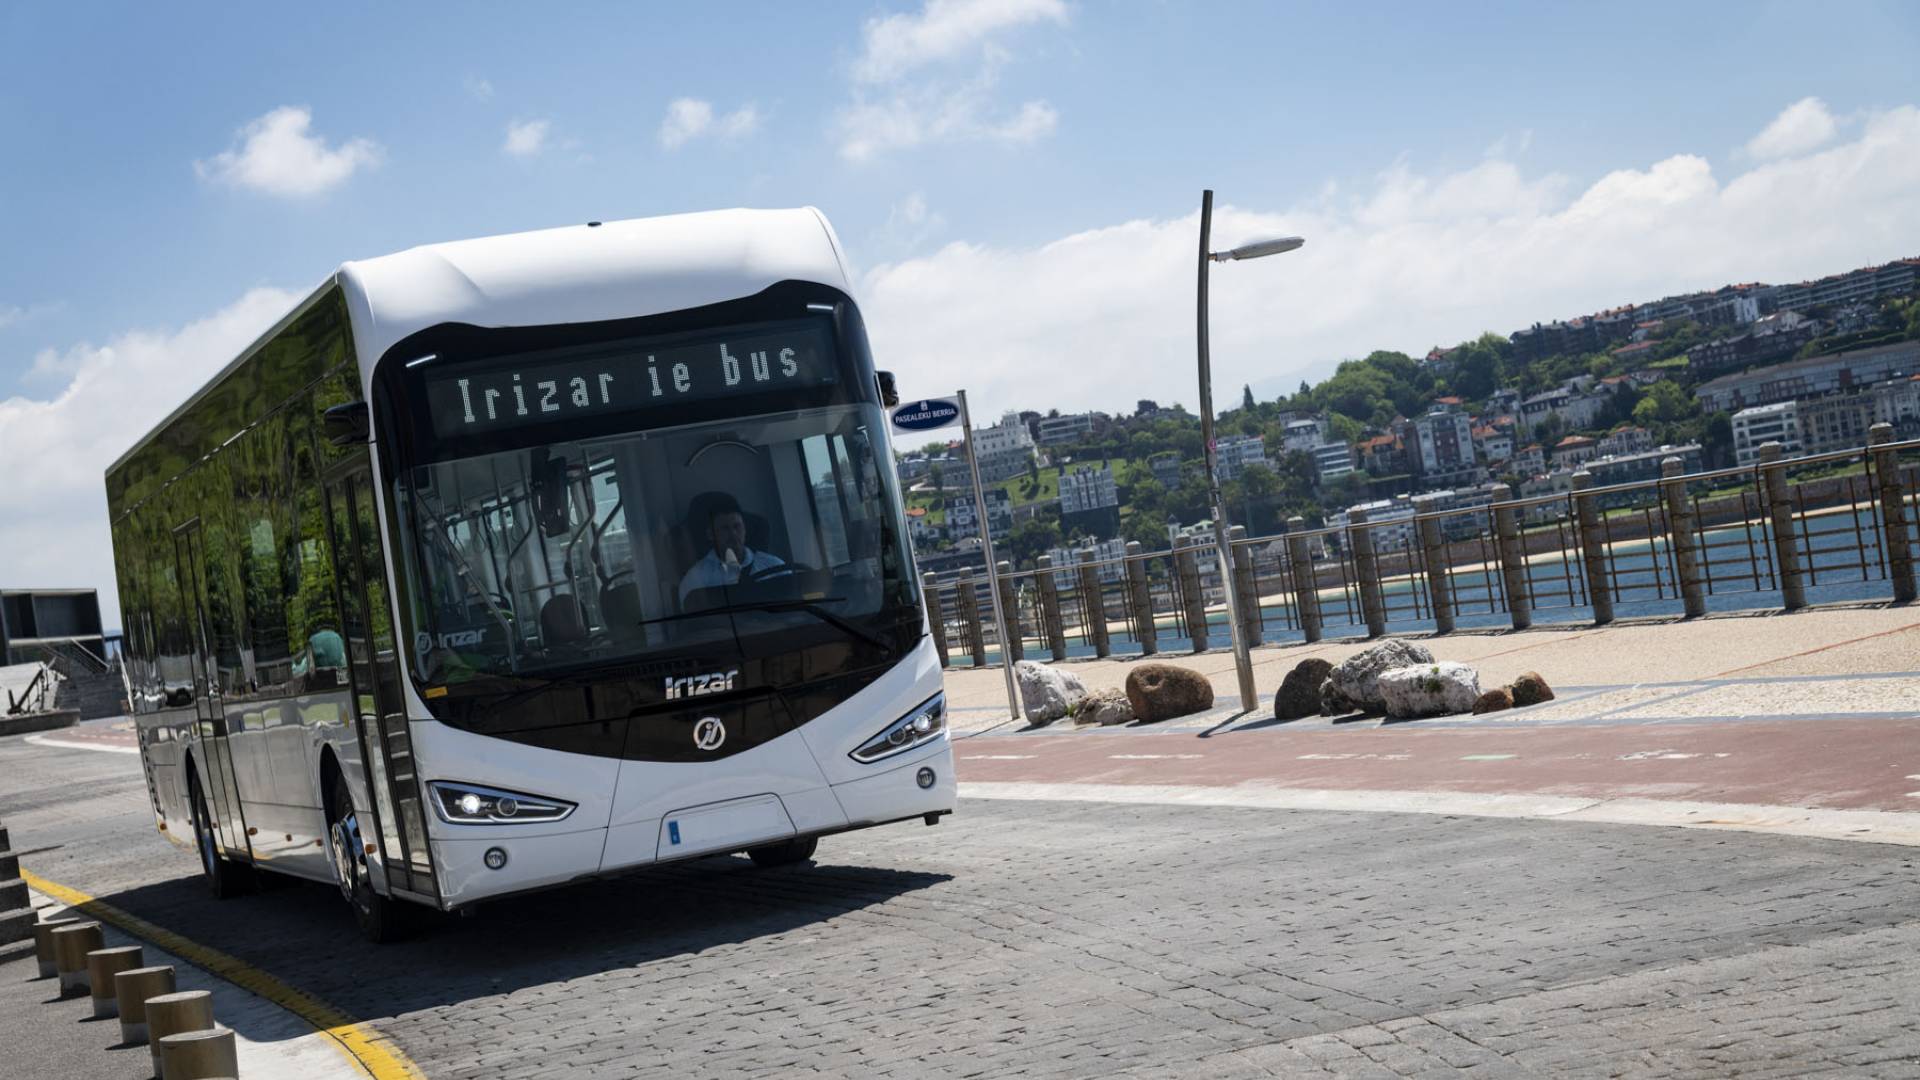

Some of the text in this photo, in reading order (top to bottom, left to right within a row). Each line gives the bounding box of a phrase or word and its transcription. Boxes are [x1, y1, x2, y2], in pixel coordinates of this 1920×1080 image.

[458, 343, 798, 423] Irizar ie bus
[895, 408, 956, 424] PASEALEKU BERRIA
